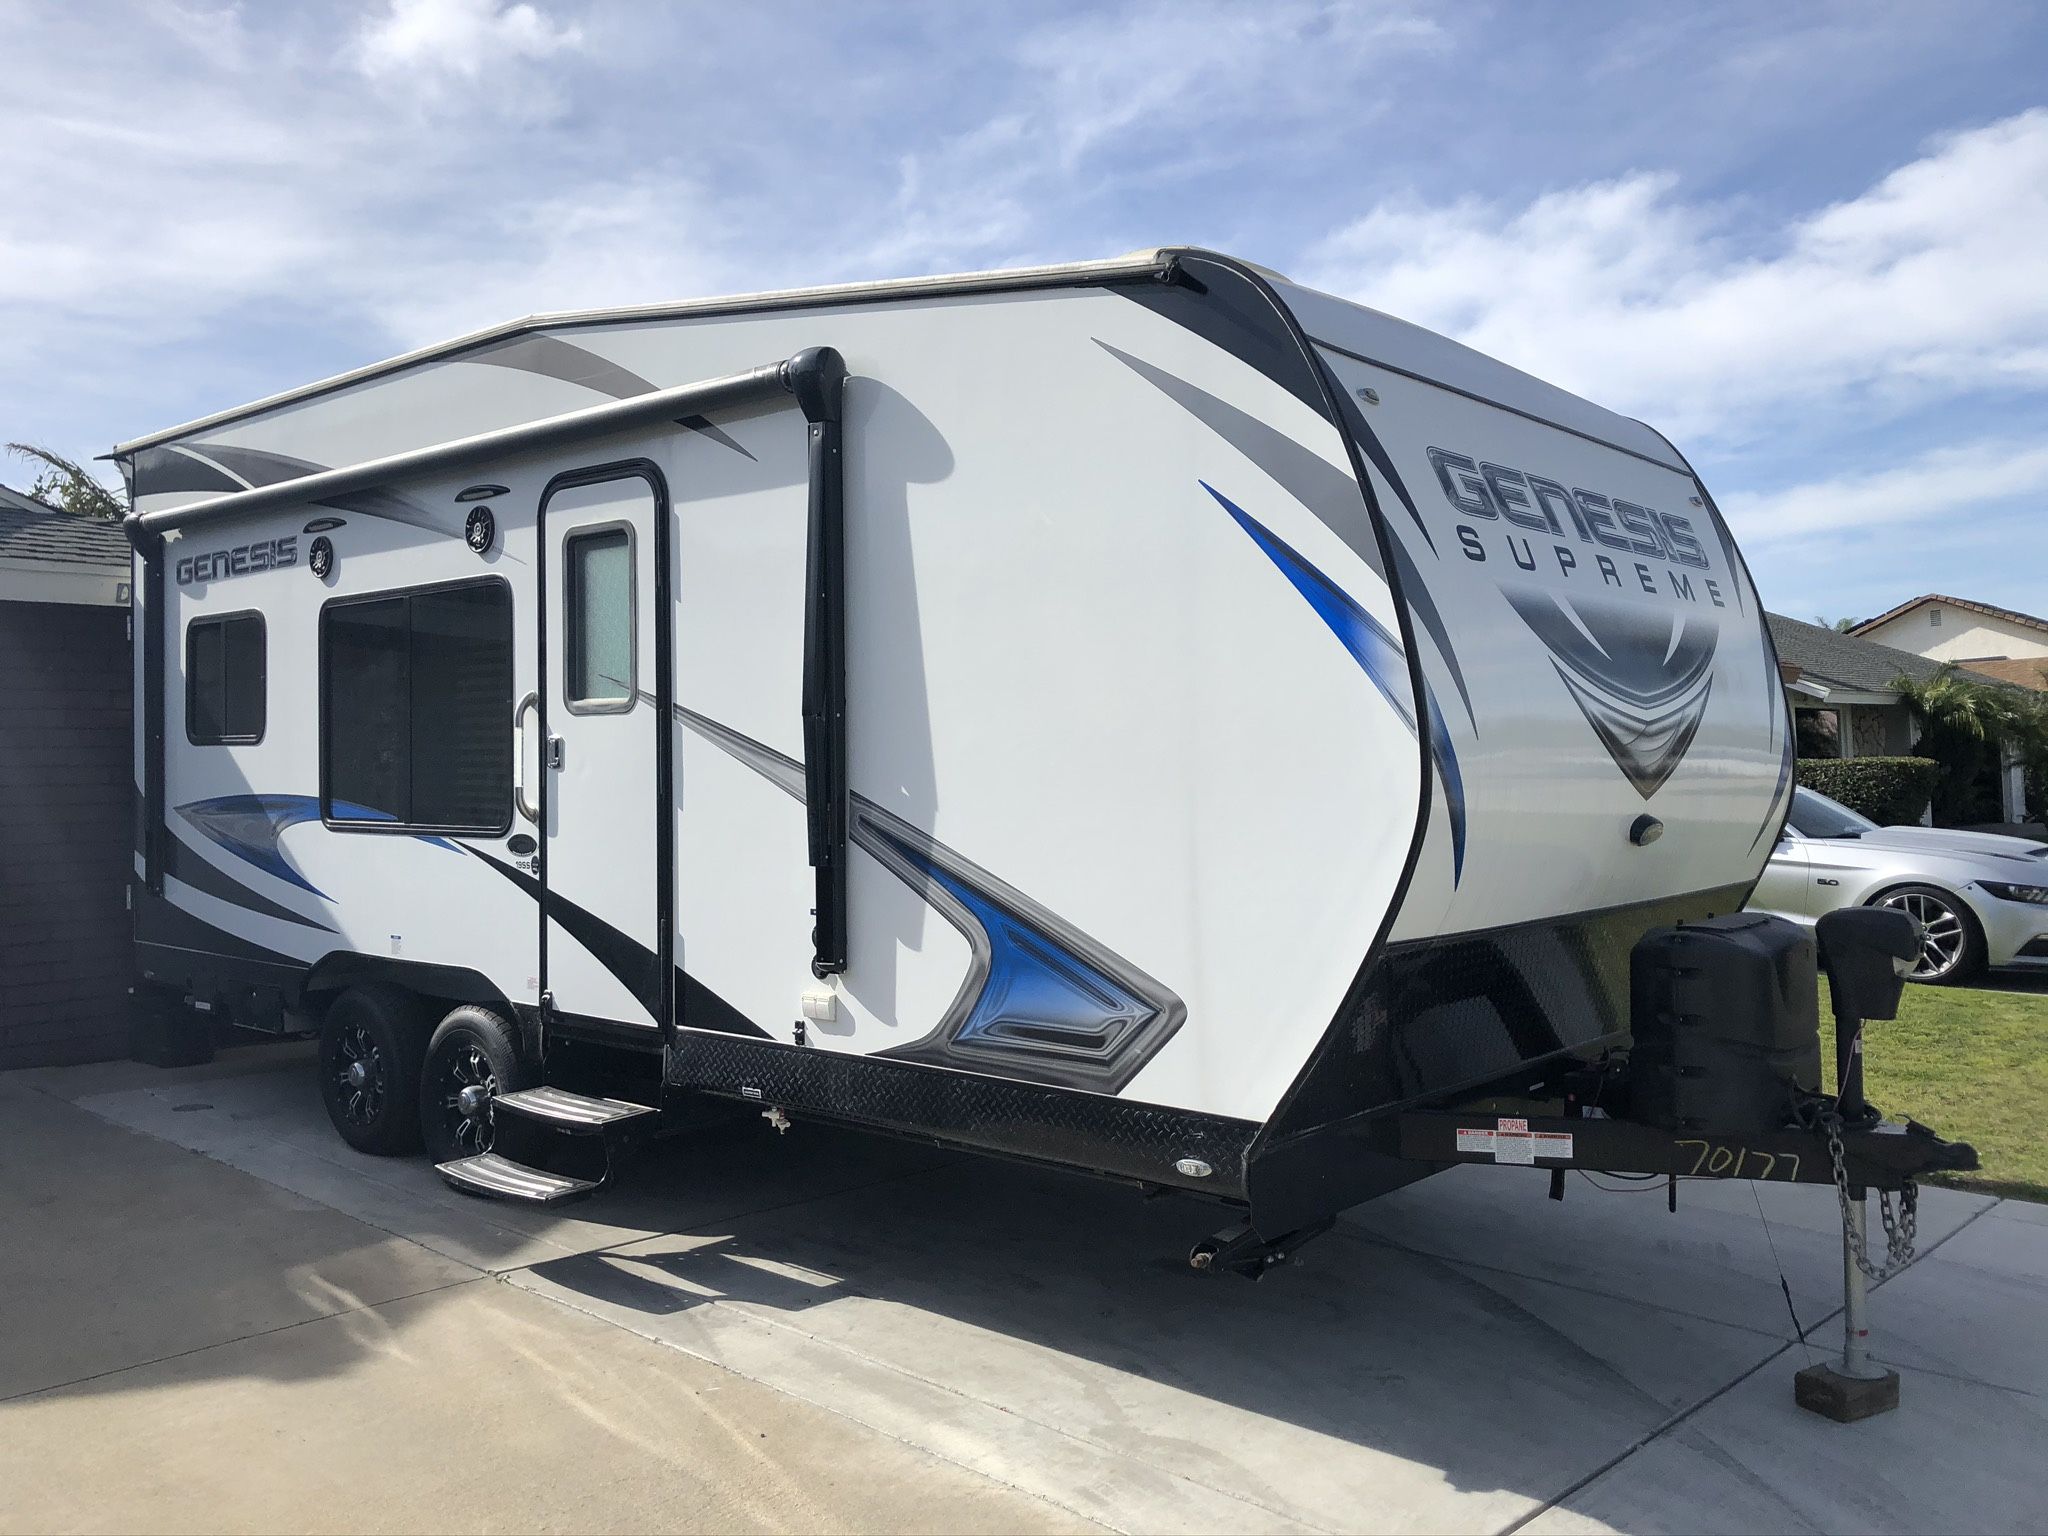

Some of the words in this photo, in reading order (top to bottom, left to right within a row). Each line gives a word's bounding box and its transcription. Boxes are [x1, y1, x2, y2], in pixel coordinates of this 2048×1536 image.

[1426, 445, 1711, 571] GENESIS
[176, 535, 298, 586] GENESIS
[1456, 524, 1726, 608] SUPREME
[1499, 1119, 1527, 1132] PROPANE
[1674, 1139, 1800, 1182] 70177
